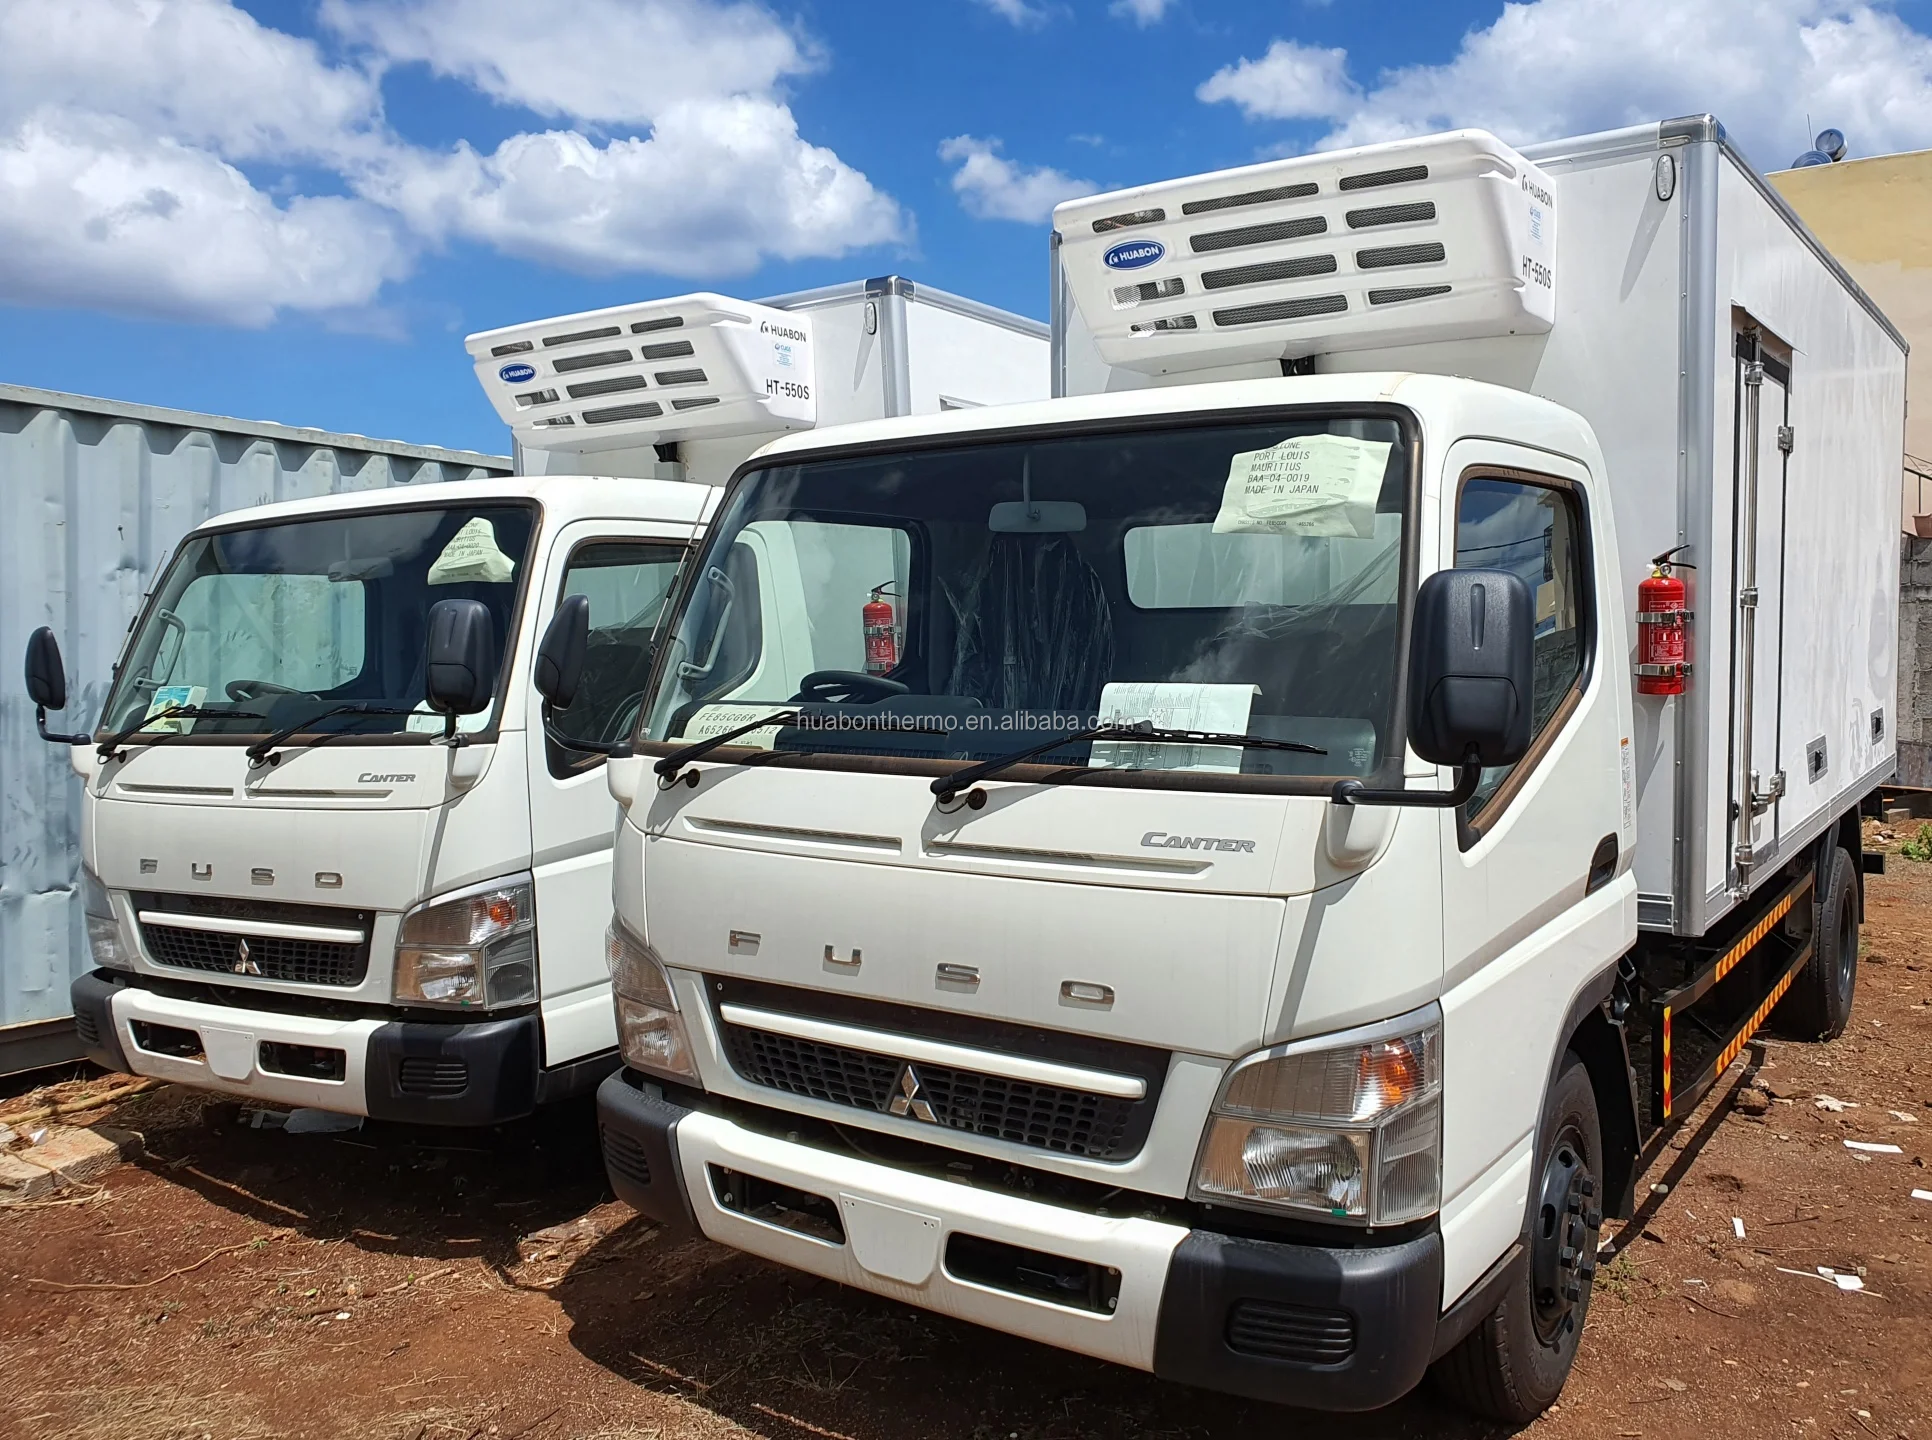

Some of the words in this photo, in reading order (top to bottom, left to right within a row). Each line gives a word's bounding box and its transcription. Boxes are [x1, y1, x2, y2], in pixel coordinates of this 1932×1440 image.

[1528, 181, 1553, 209] HUABON
[1119, 245, 1160, 262] HUABON
[1522, 254, 1552, 289] HT-550S
[770, 324, 807, 343] HUABON
[508, 368, 533, 378] HUABON
[765, 378, 810, 400] HT-550S
[1253, 451, 1276, 462] PORT
[1280, 450, 1310, 461] LOUIS
[1250, 462, 1301, 472] MAURITIUS
[1247, 473, 1310, 483] BAA-04-0019
[1244, 484, 1267, 494] MADE
[1272, 484, 1285, 494] IN
[1288, 484, 1319, 494] JAPAN
[140, 858, 344, 888] FUSO
[728, 928, 1116, 1010] FUSO
